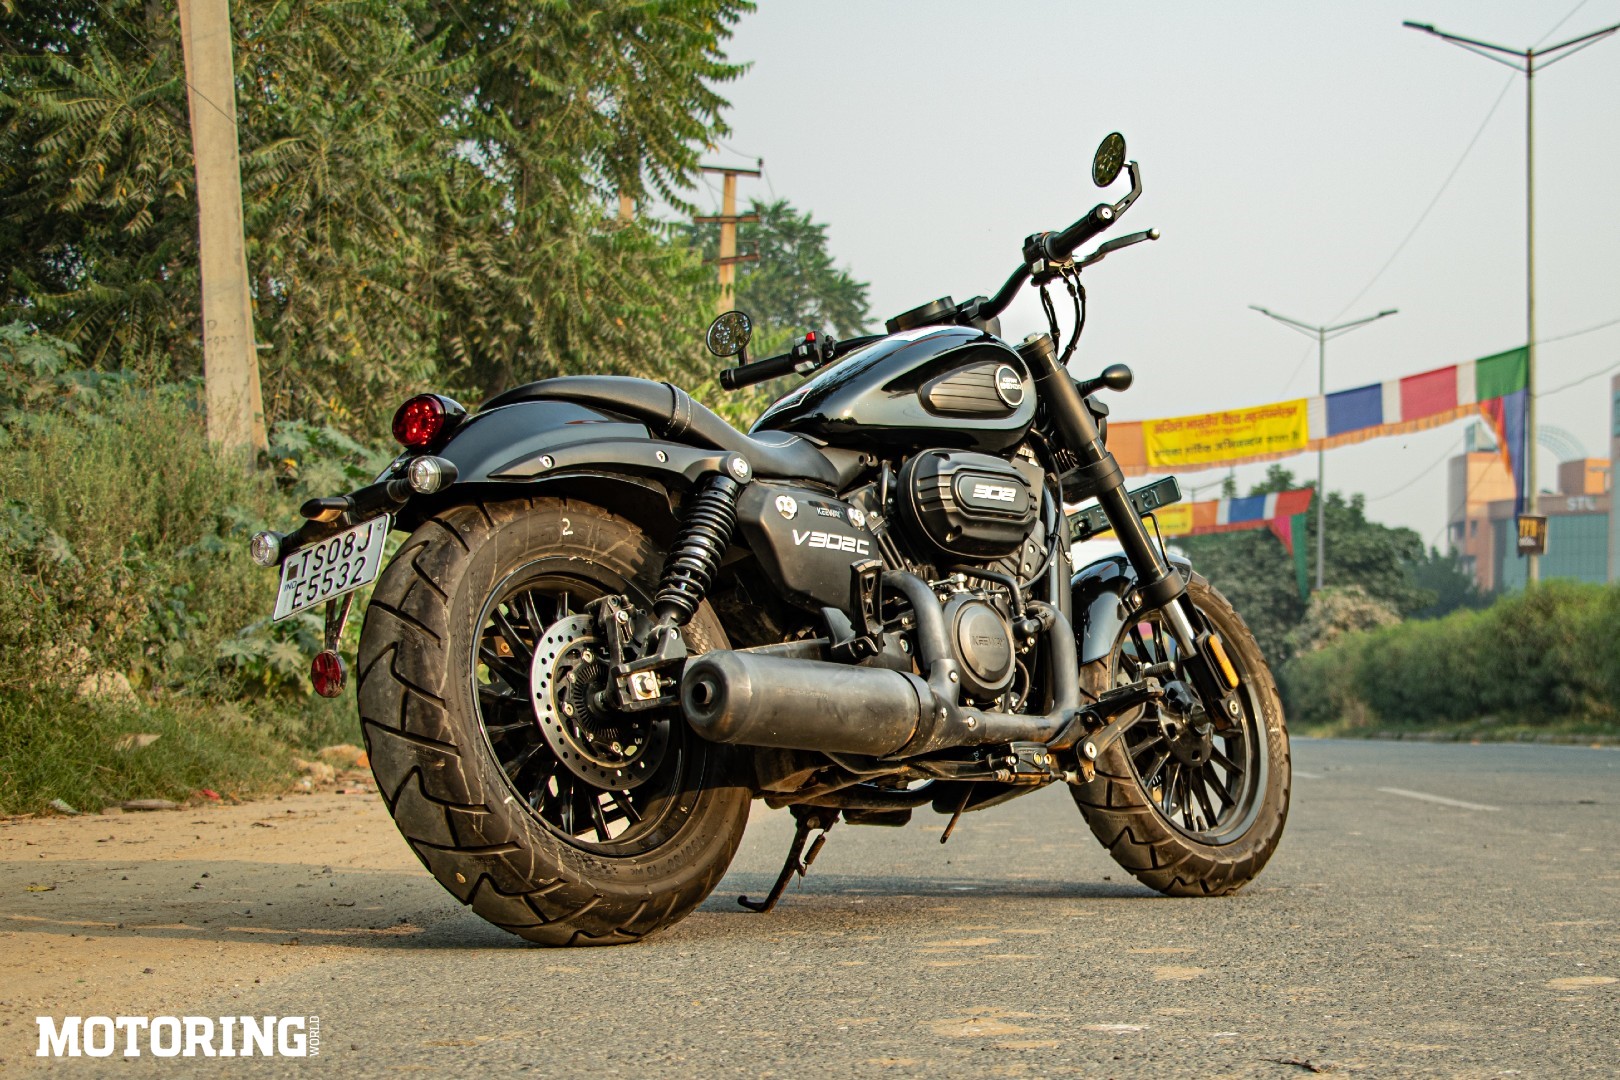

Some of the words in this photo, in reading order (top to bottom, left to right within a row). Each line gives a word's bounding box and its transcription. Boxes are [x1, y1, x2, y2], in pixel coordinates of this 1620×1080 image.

[972, 483, 1017, 502] 302
[562, 517, 573, 536] 2
[302, 523, 374, 577] TS08J
[792, 528, 870, 556] V302C
[283, 580, 298, 592] IND
[291, 556, 367, 610] E5532
